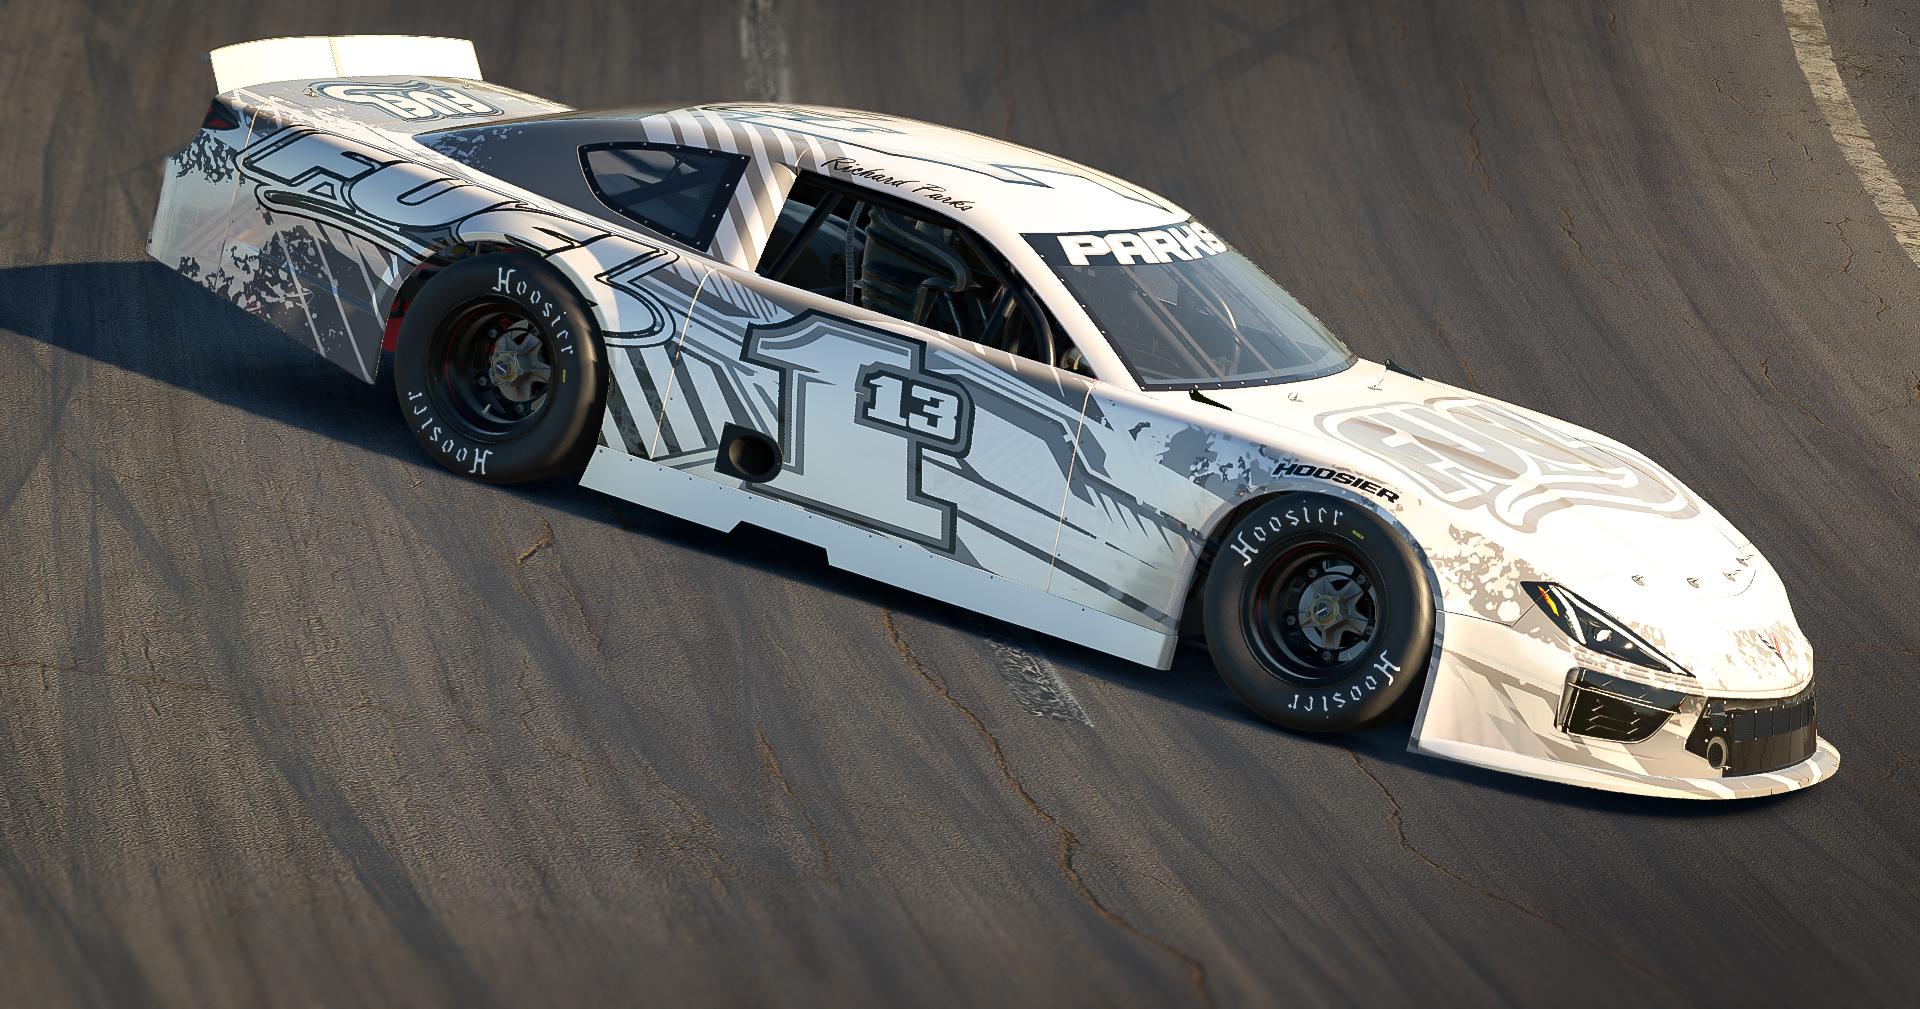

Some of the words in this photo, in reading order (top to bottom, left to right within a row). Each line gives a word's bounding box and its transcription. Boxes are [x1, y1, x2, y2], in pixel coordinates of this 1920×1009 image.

[821, 156, 920, 188] Richard
[911, 183, 976, 212] Parks
[1056, 221, 1228, 266] PARKS
[492, 266, 574, 354] Hoosier
[408, 391, 494, 475] Hoosier
[864, 368, 964, 446] 13
[1272, 461, 1400, 504] HOOSIER
[1230, 499, 1344, 567] Hoosier
[1287, 649, 1401, 719] Hoosier
